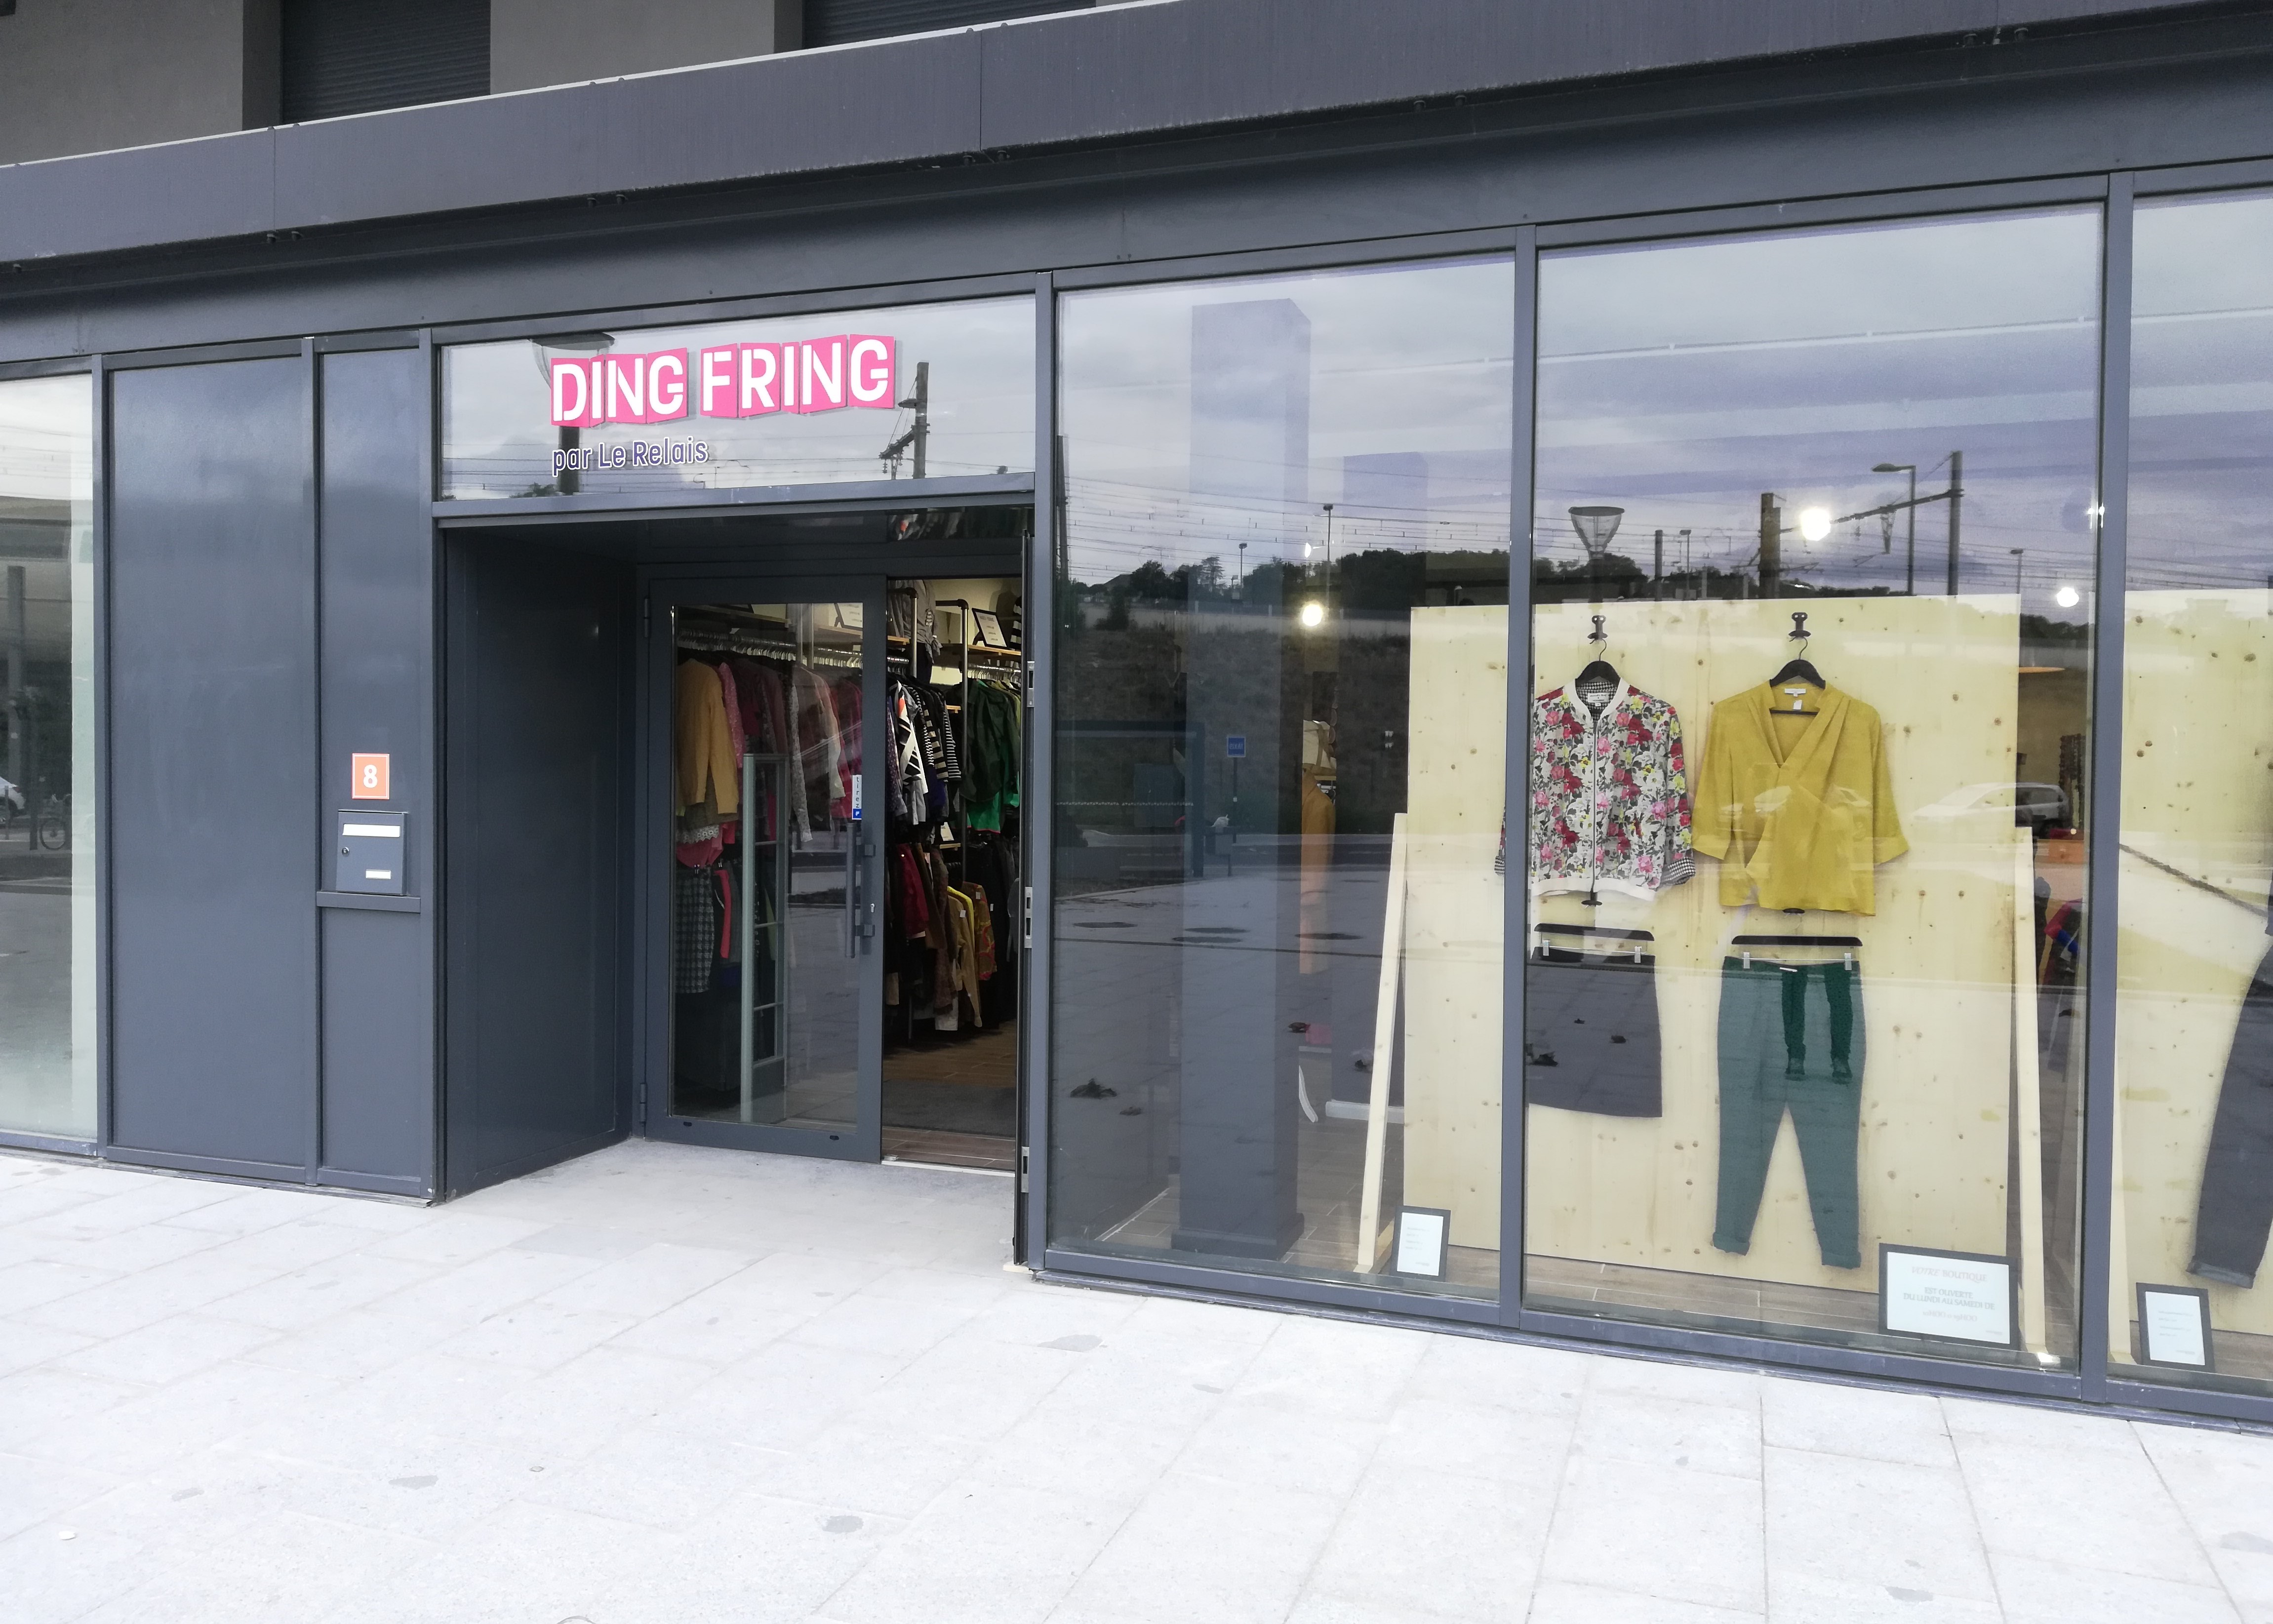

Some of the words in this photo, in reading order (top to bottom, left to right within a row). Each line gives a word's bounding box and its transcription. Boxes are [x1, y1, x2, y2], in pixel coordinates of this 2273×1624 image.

[553, 355, 683, 421] DING
[703, 339, 889, 412] FRING
[552, 447, 592, 477] par
[598, 442, 626, 469] Le
[633, 436, 709, 466] Relais
[363, 764, 378, 788] 8
[1912, 1266, 1940, 1277] VOTRE
[1942, 1269, 1988, 1283] BOUTIQUE
[1916, 1295, 1940, 1304] LUNDI
[1954, 1299, 1983, 1308] SAMEDI
[1939, 1288, 1973, 1299] OUVERTE
